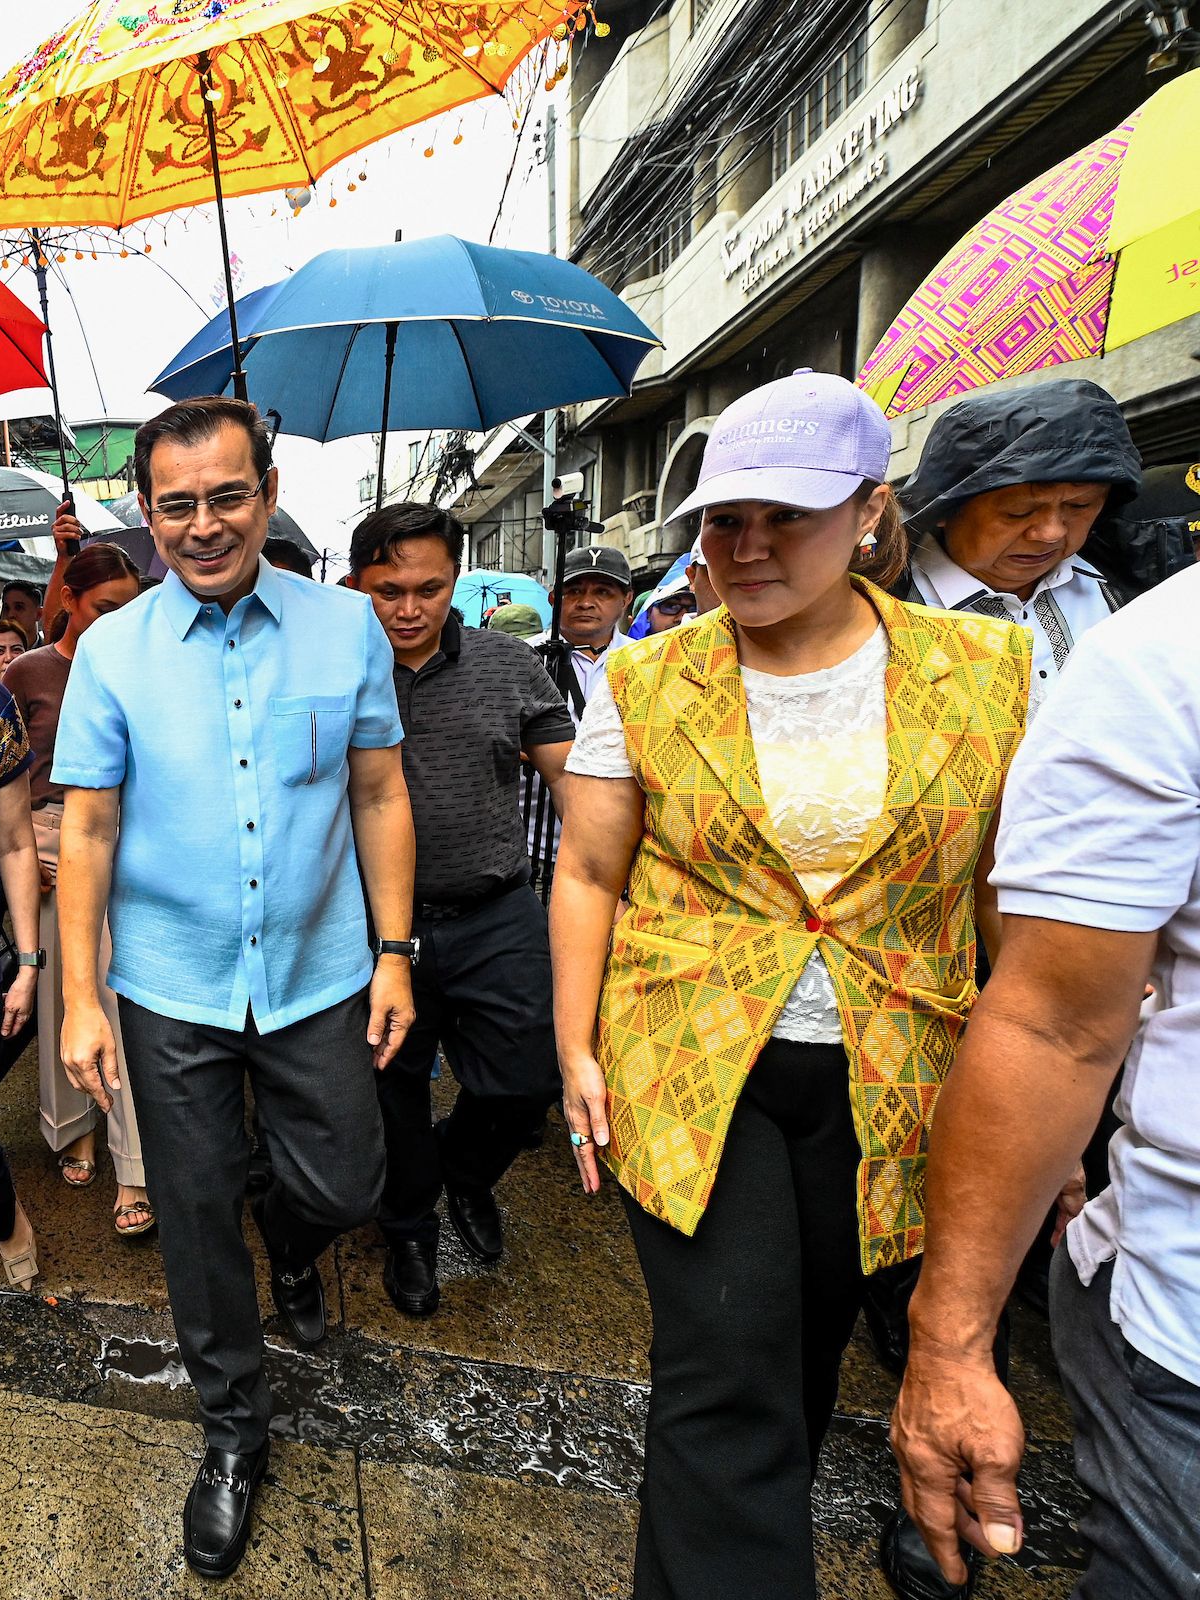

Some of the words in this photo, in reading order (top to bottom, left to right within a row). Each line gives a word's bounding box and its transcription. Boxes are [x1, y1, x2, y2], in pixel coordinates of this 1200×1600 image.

[787, 66, 924, 216] MARKETING
[740, 237, 792, 293] ELECTRICAL
[794, 227, 805, 246] &
[805, 152, 887, 239] ELECTRONICS
[536, 295, 603, 314] TOYOTA
[589, 549, 602, 567] Y
